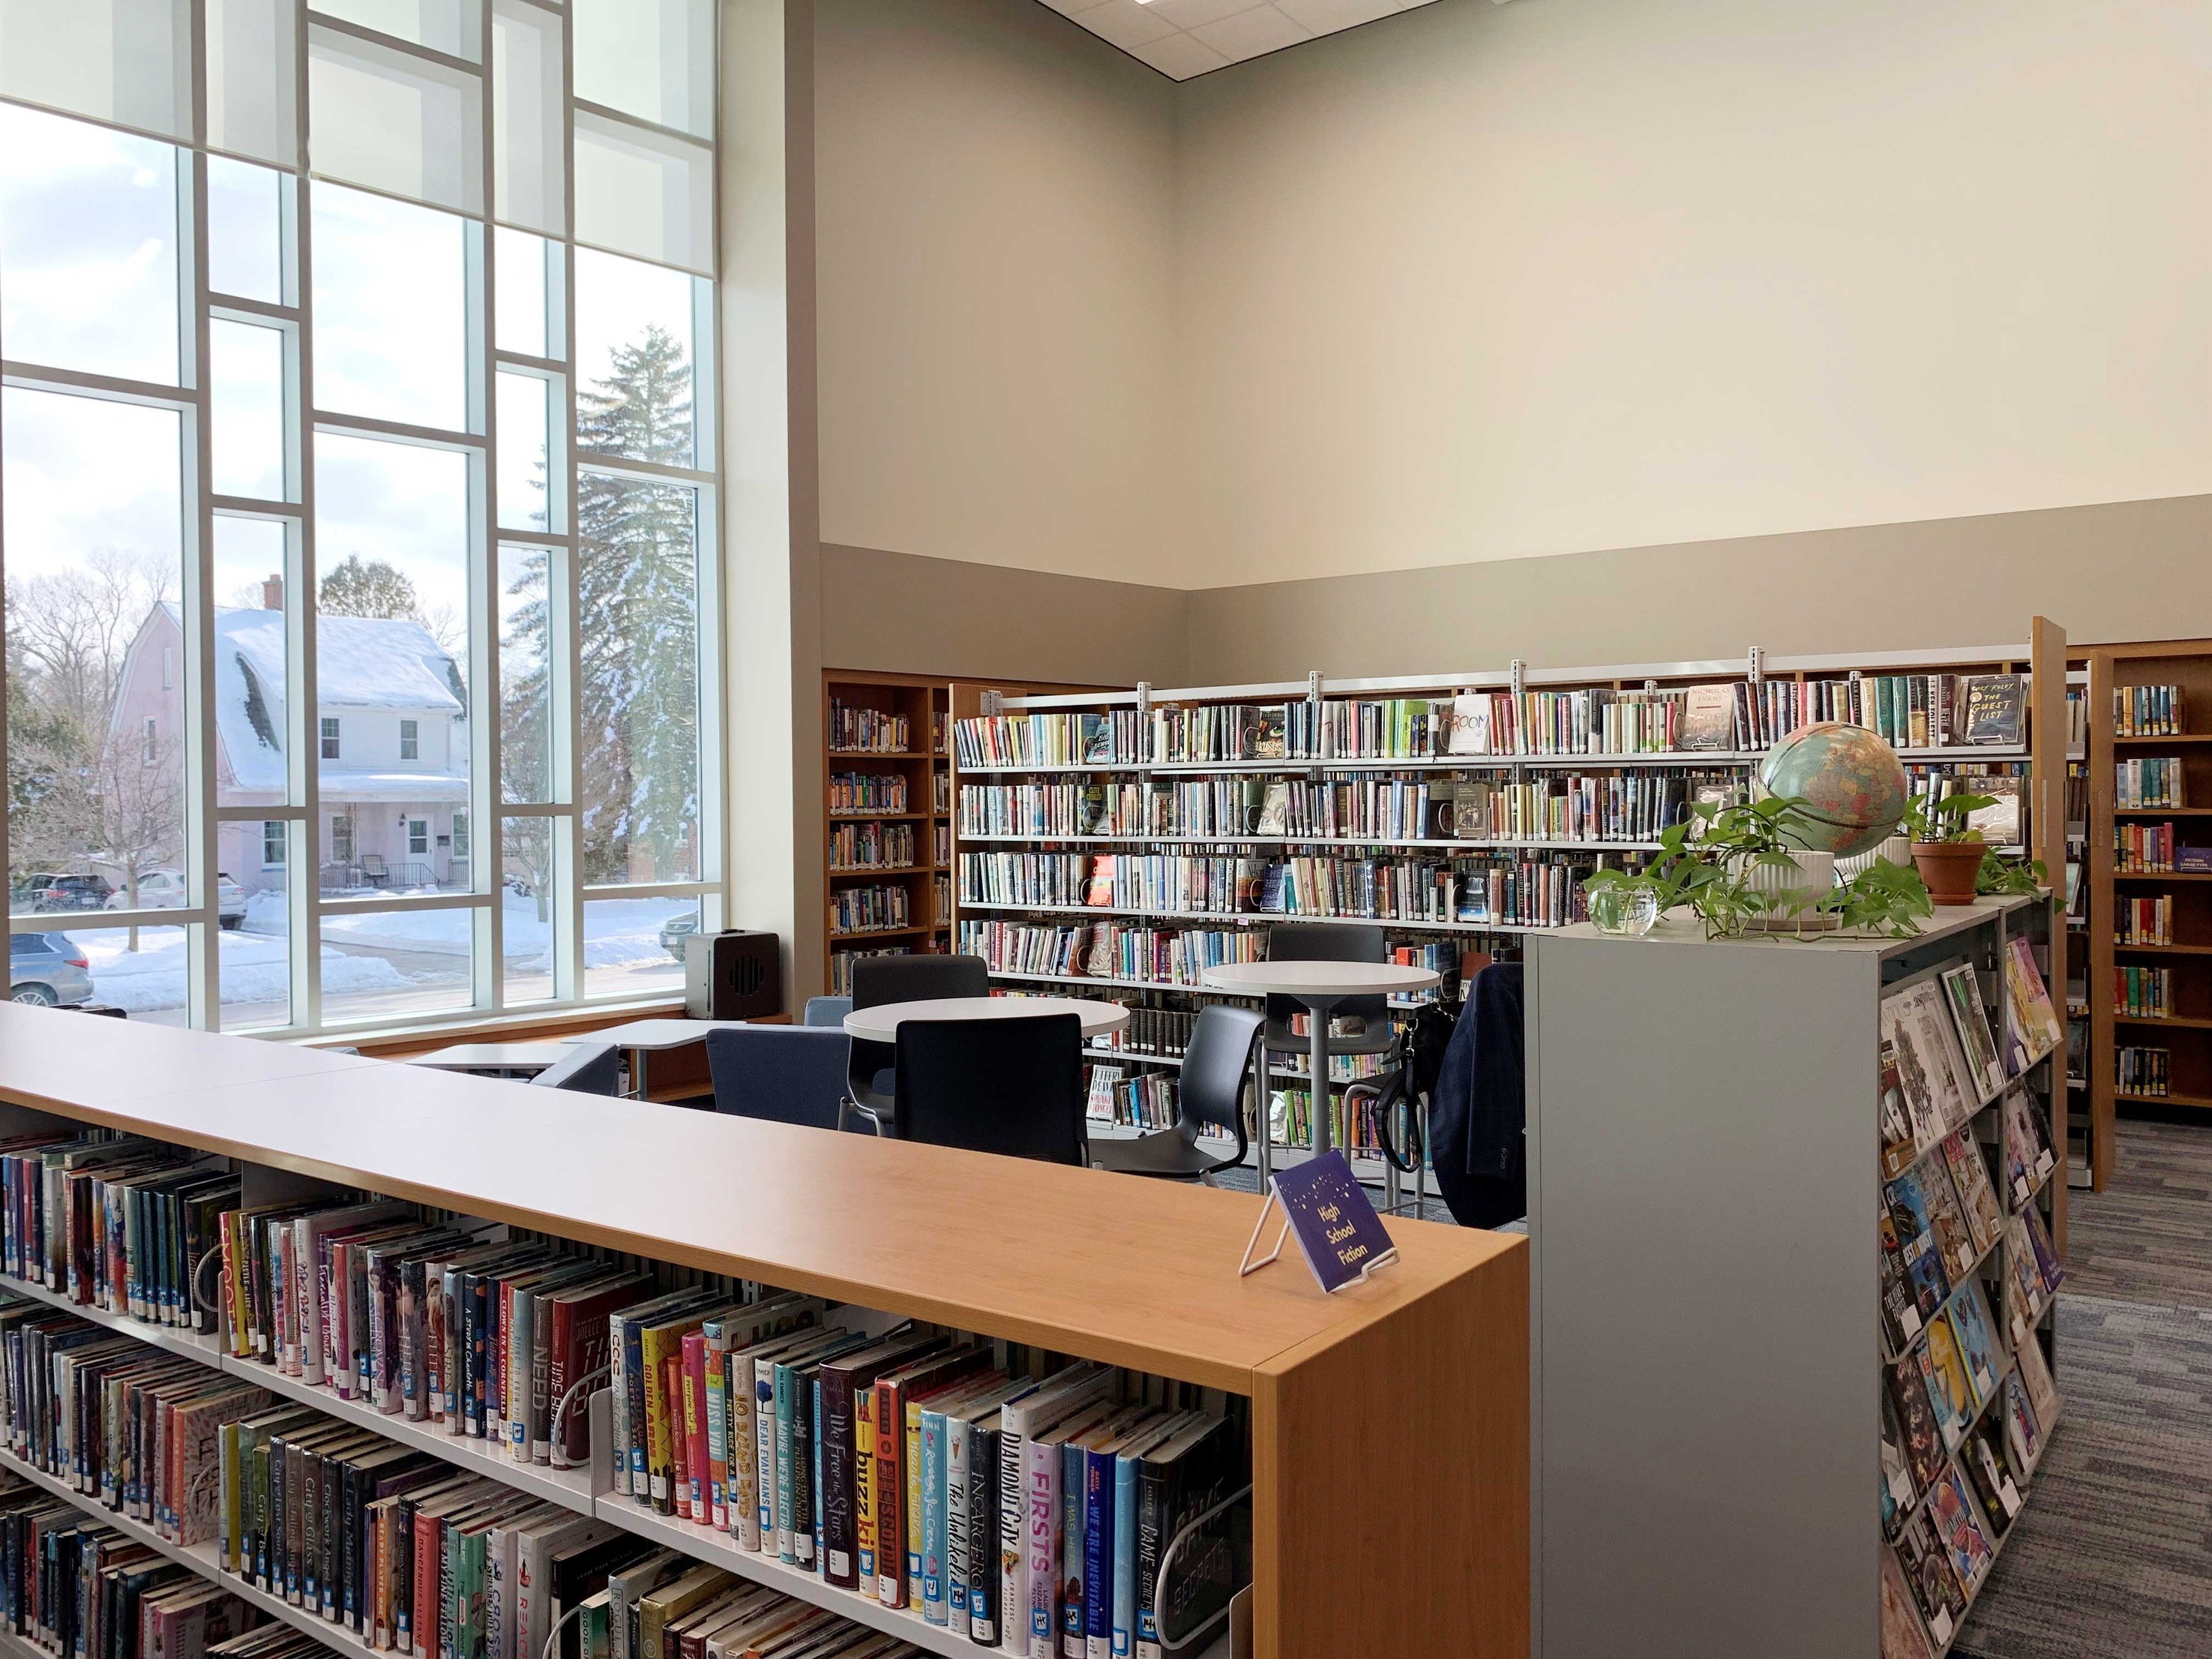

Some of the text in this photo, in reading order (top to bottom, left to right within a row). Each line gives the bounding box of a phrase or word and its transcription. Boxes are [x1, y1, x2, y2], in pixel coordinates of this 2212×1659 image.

[1972, 700, 2012, 715] GUEST
[1983, 693, 2001, 702] THE
[1452, 714, 1489, 733] ROOM
[1980, 711, 2004, 722] LIST
[1317, 1202, 1341, 1222] High
[1326, 1219, 1356, 1245] School
[1337, 1244, 1368, 1266] Fiction
[373, 1316, 386, 1382] CROWN
[501, 1334, 507, 1345] IN
[576, 1324, 601, 1342] JOELLE
[501, 1347, 507, 1355] A
[444, 1346, 454, 1392] SIREN
[465, 1351, 473, 1392] Charlotte
[514, 1366, 521, 1376] TO
[533, 1345, 548, 1411] NEED
[644, 1363, 657, 1459] GOLDEN ARM
[735, 1393, 749, 1417] 10
[707, 1392, 721, 1455] MISS YOU
[778, 1418, 788, 1454] MAYBE
[760, 1419, 771, 1505] DEAR EVAN HANS
[778, 1456, 789, 1486] WE'RE
[825, 1404, 848, 1540] We Free the Stars
[288, 1470, 297, 1495] City
[303, 1478, 314, 1508] City
[949, 1483, 964, 1507] The
[1002, 1431, 1022, 1547] DIAMOND CITY
[256, 1494, 265, 1522] City
[343, 1488, 354, 1526] Lady
[1032, 1471, 1050, 1573] FIRSTS
[1067, 1504, 1075, 1532] WAS
[305, 1526, 316, 1566] Glass
[323, 1484, 331, 1582] Clockwork Angel
[970, 1470, 985, 1589] INCARCERO
[440, 1554, 448, 1572] MY
[1089, 1505, 1100, 1631] WE ARE INEVITABLE
[1140, 1523, 1158, 1611] GAME SECRETS
[439, 1601, 448, 1647] FELLOW
[613, 1592, 622, 1642] ROGUE
